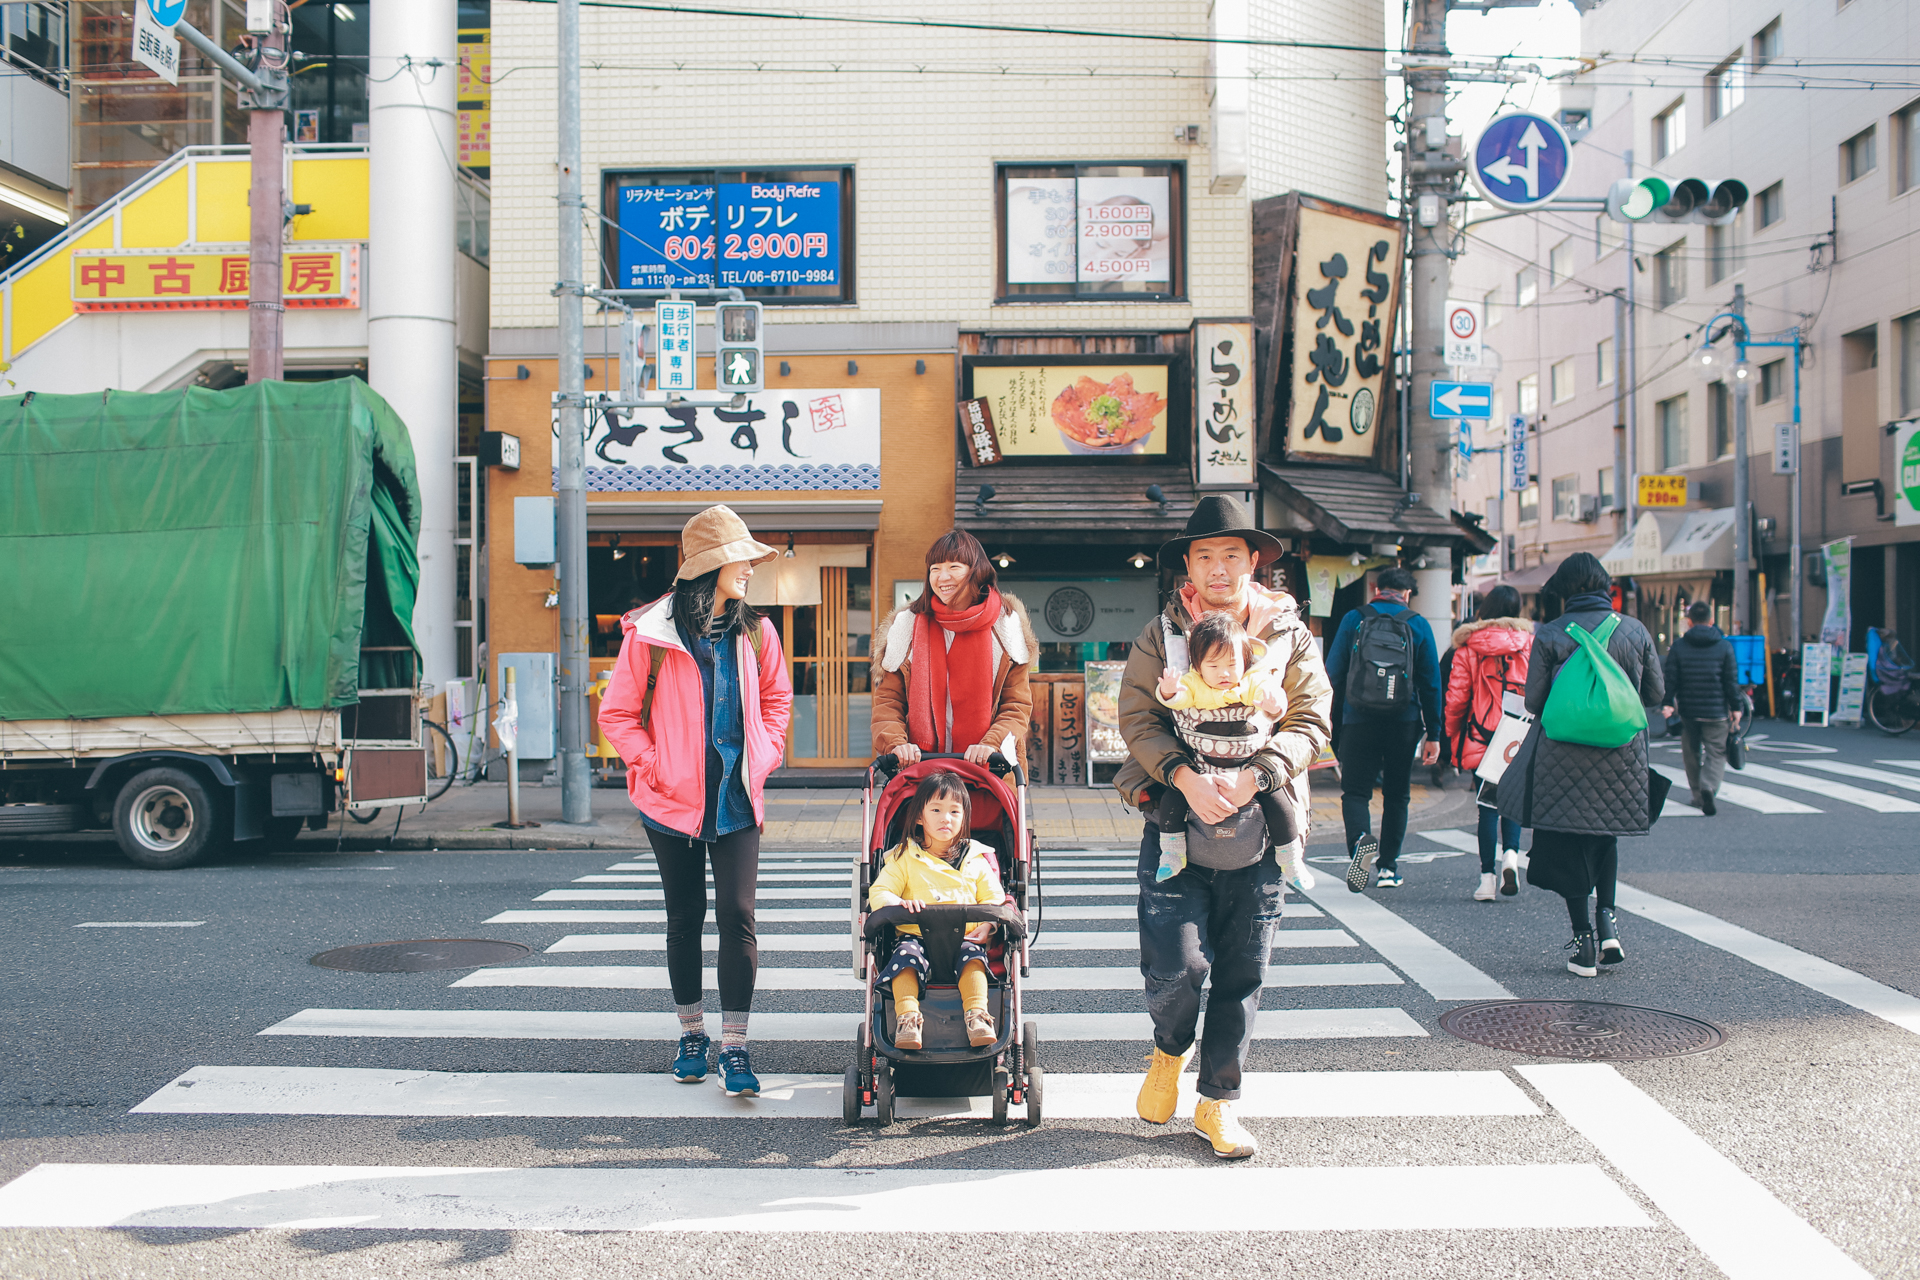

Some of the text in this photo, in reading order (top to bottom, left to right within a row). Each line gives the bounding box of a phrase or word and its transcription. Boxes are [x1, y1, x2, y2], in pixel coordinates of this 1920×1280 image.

[139, 27, 177, 74] 自転車を除く
[751, 185, 785, 202] Body
[727, 205, 799, 230] リフレ
[1086, 206, 1150, 220] 1,600円
[1084, 224, 1150, 238] 2,900円
[723, 233, 828, 261] 2,900円
[721, 269, 835, 284] TEL/06-6710-9984
[1084, 260, 1150, 273] 4,500円
[1354, 240, 1390, 379] らーめん
[1455, 315, 1471, 331] 30
[662, 307, 675, 352] 自転車
[677, 307, 690, 352] 歩行者
[1304, 252, 1355, 443] 天地人
[670, 355, 682, 386] 専用
[1206, 340, 1246, 444] らーめん
